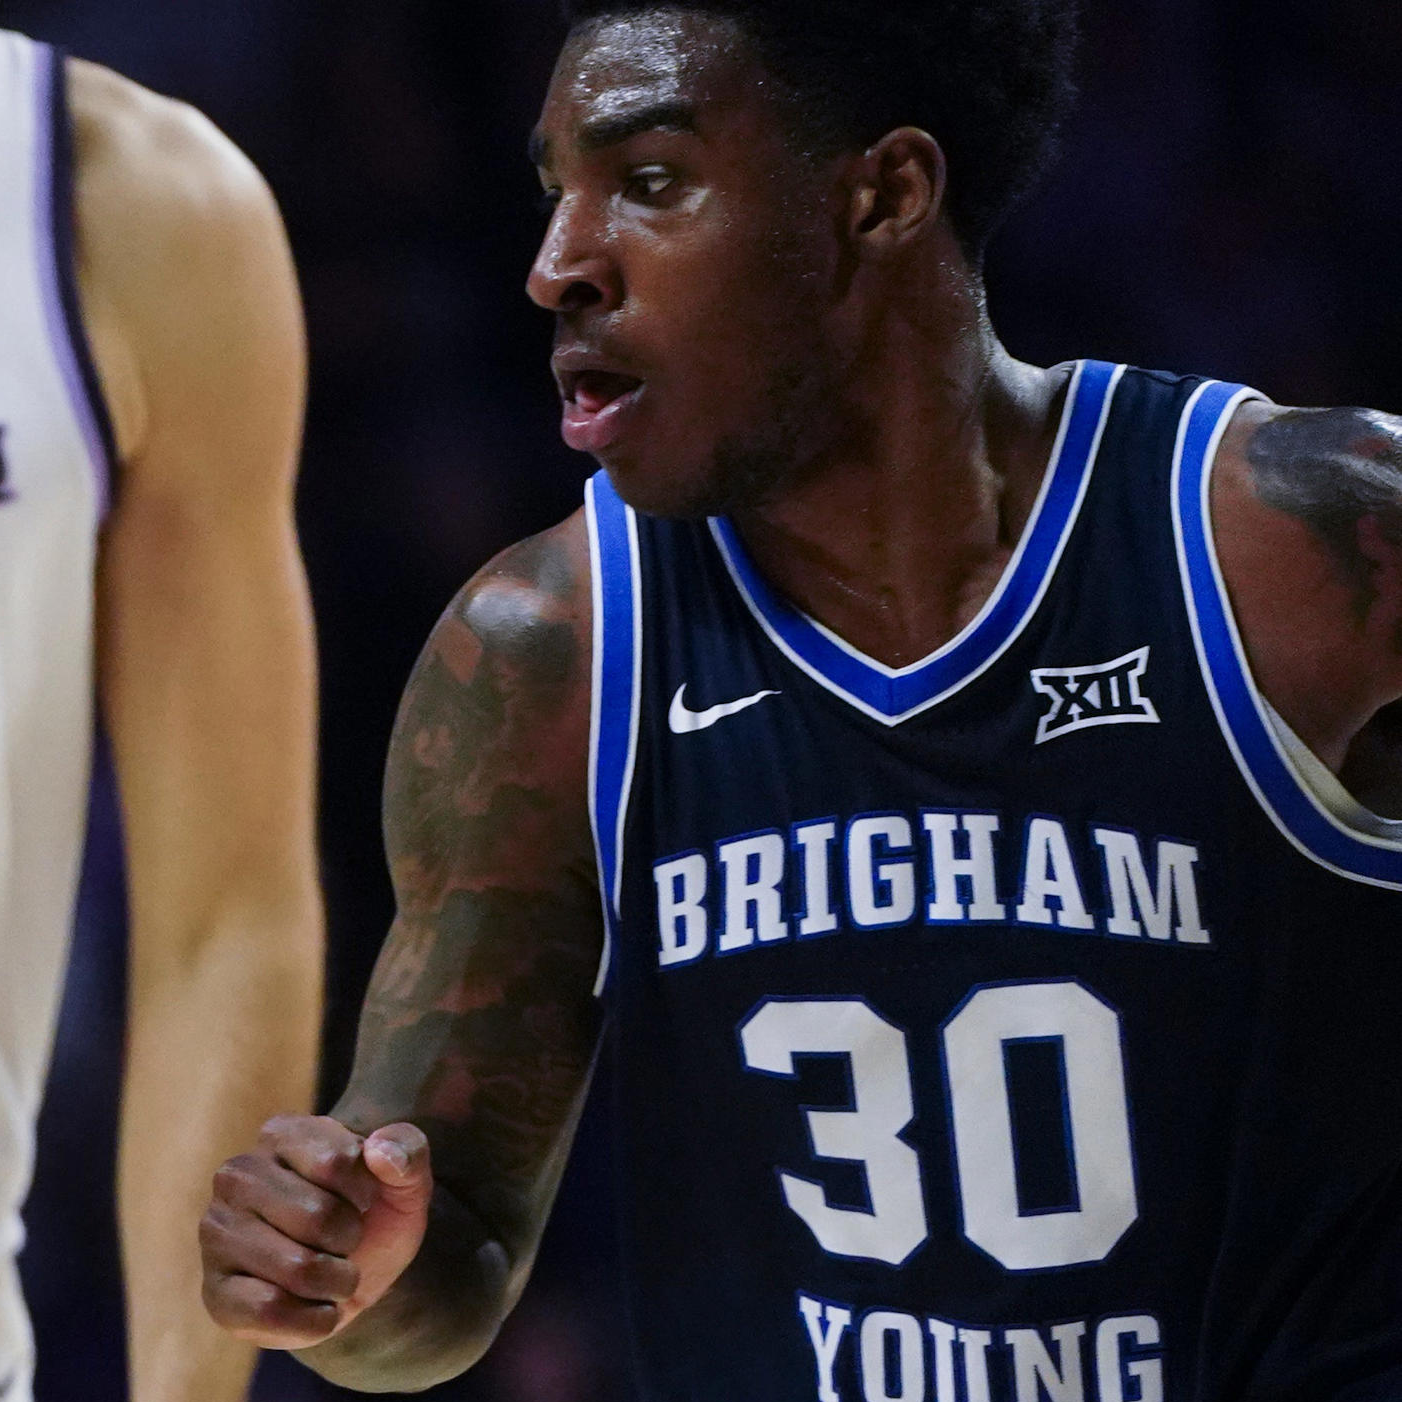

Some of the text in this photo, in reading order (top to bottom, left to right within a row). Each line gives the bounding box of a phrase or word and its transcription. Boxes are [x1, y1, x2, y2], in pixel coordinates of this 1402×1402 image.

[1030, 646, 1161, 745] XII
[653, 812, 1212, 967] BRIGHAM
[739, 980, 1139, 1270] 30
